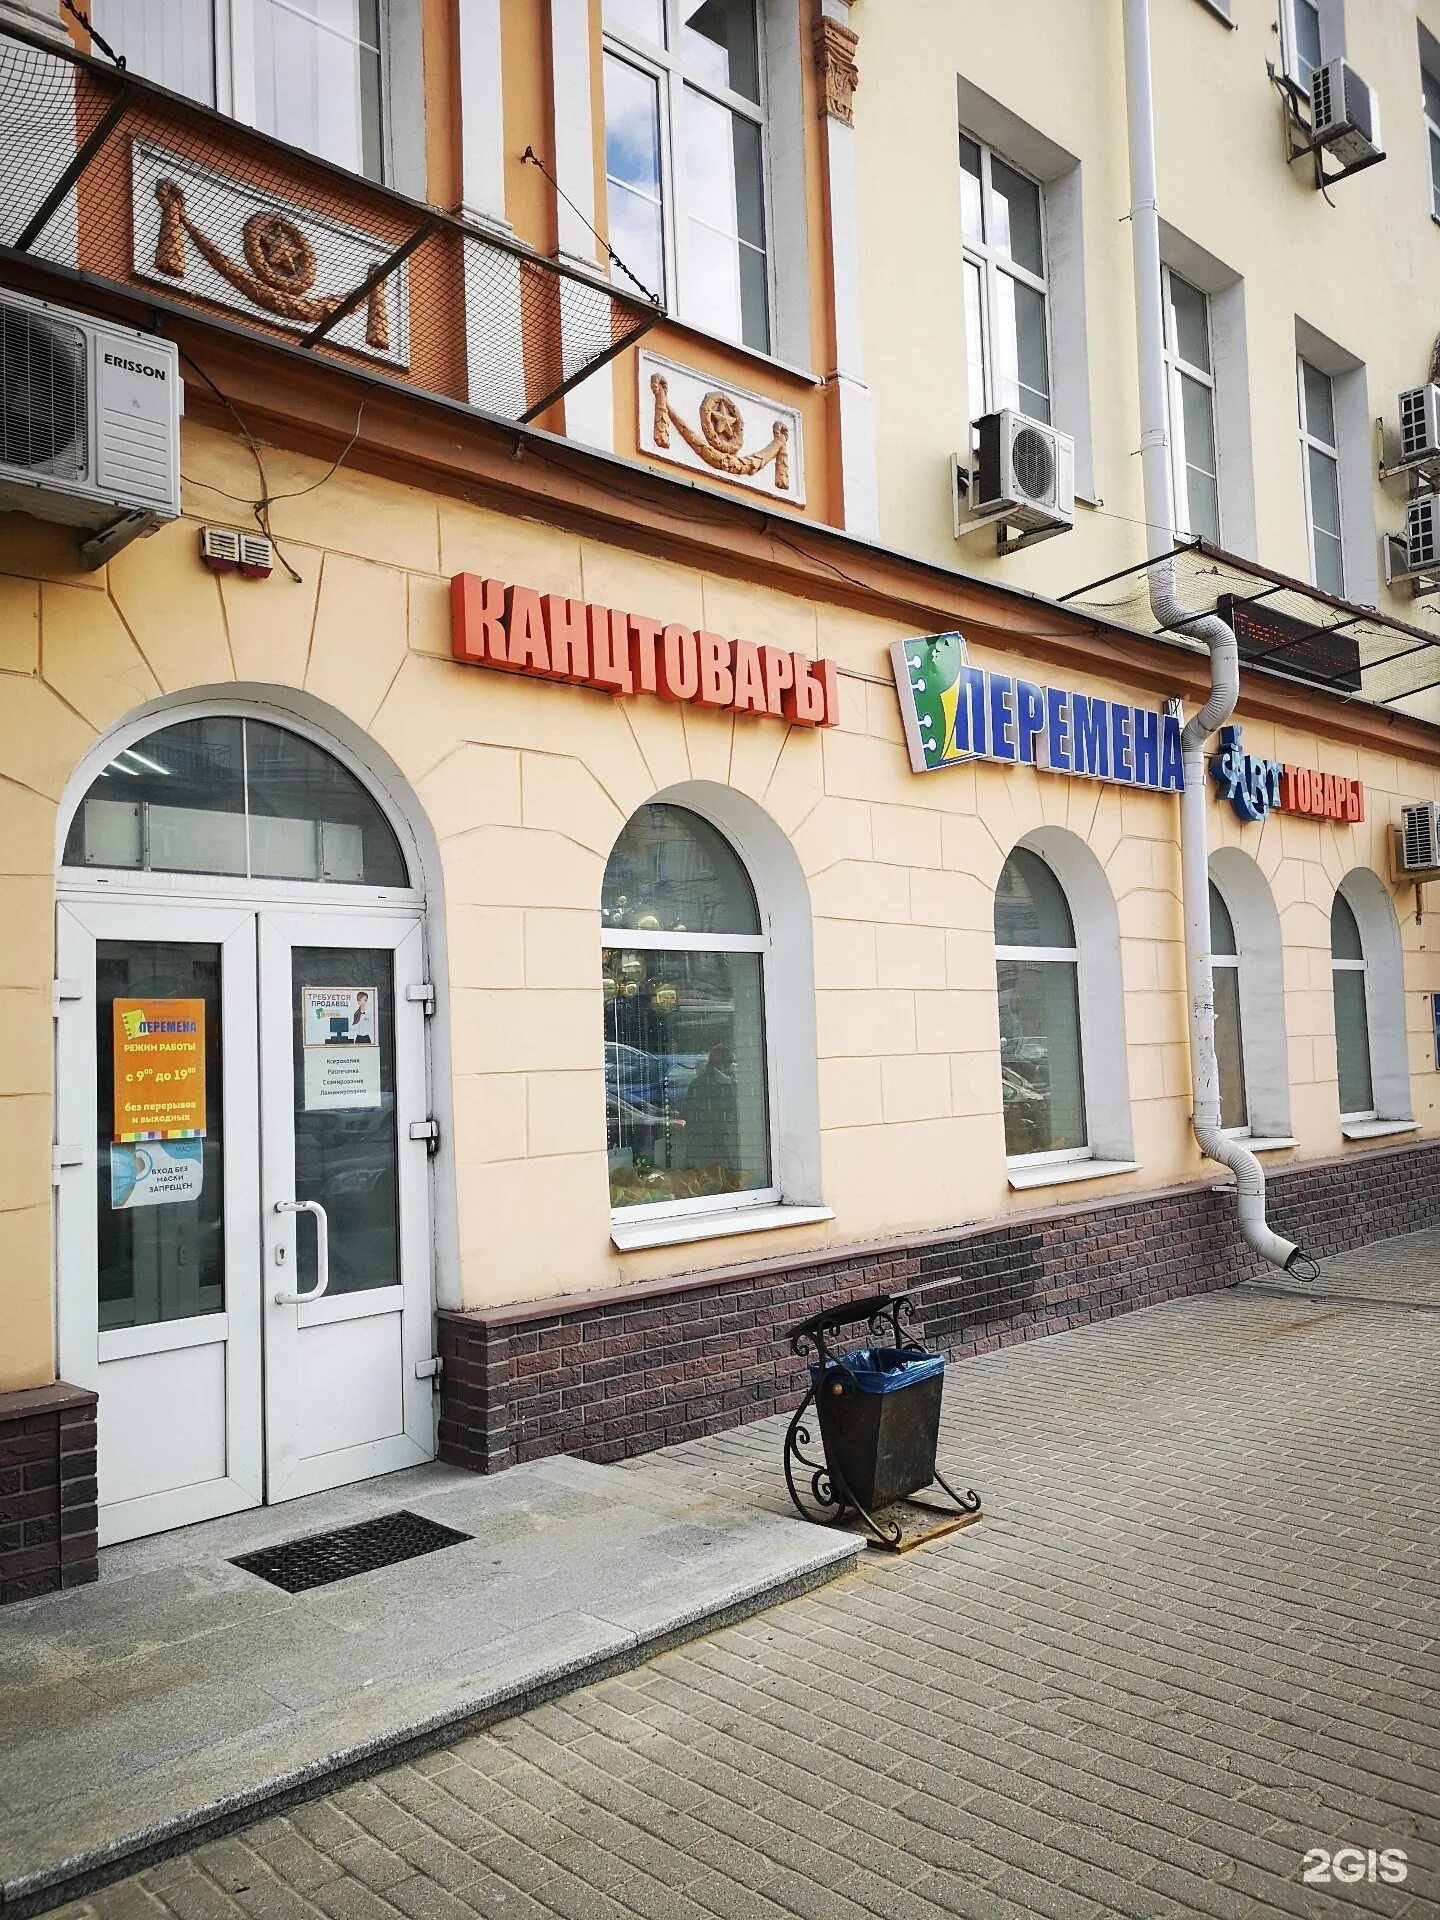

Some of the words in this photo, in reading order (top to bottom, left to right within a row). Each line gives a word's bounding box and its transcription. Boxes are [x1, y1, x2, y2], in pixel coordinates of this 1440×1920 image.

[104, 353, 166, 381] ERISSON
[453, 572, 840, 728] КАНЦТОВАРЫ
[955, 665, 1186, 793] ПЕРЕМЕНА
[1281, 764, 1365, 823] ТОВАРЫ
[307, 993, 351, 1001] ТРЕБУЕТСЯ
[138, 1020, 197, 1033] ПЕРЕМЕНА
[124, 1043, 158, 1052] РЕЖИМ
[160, 1042, 196, 1052] РАБОТЫ
[156, 1072, 171, 1082] до
[125, 1102, 142, 1112] без
[143, 1101, 197, 1111] перерывов
[132, 1116, 138, 1124] и
[140, 1114, 190, 1124] выходных
[151, 1167, 172, 1175] ВХОД
[174, 1165, 188, 1173] БЕЗ
[156, 1174, 184, 1183] МАСКИ
[149, 1182, 193, 1193] ЗАПРЕЩЕН
